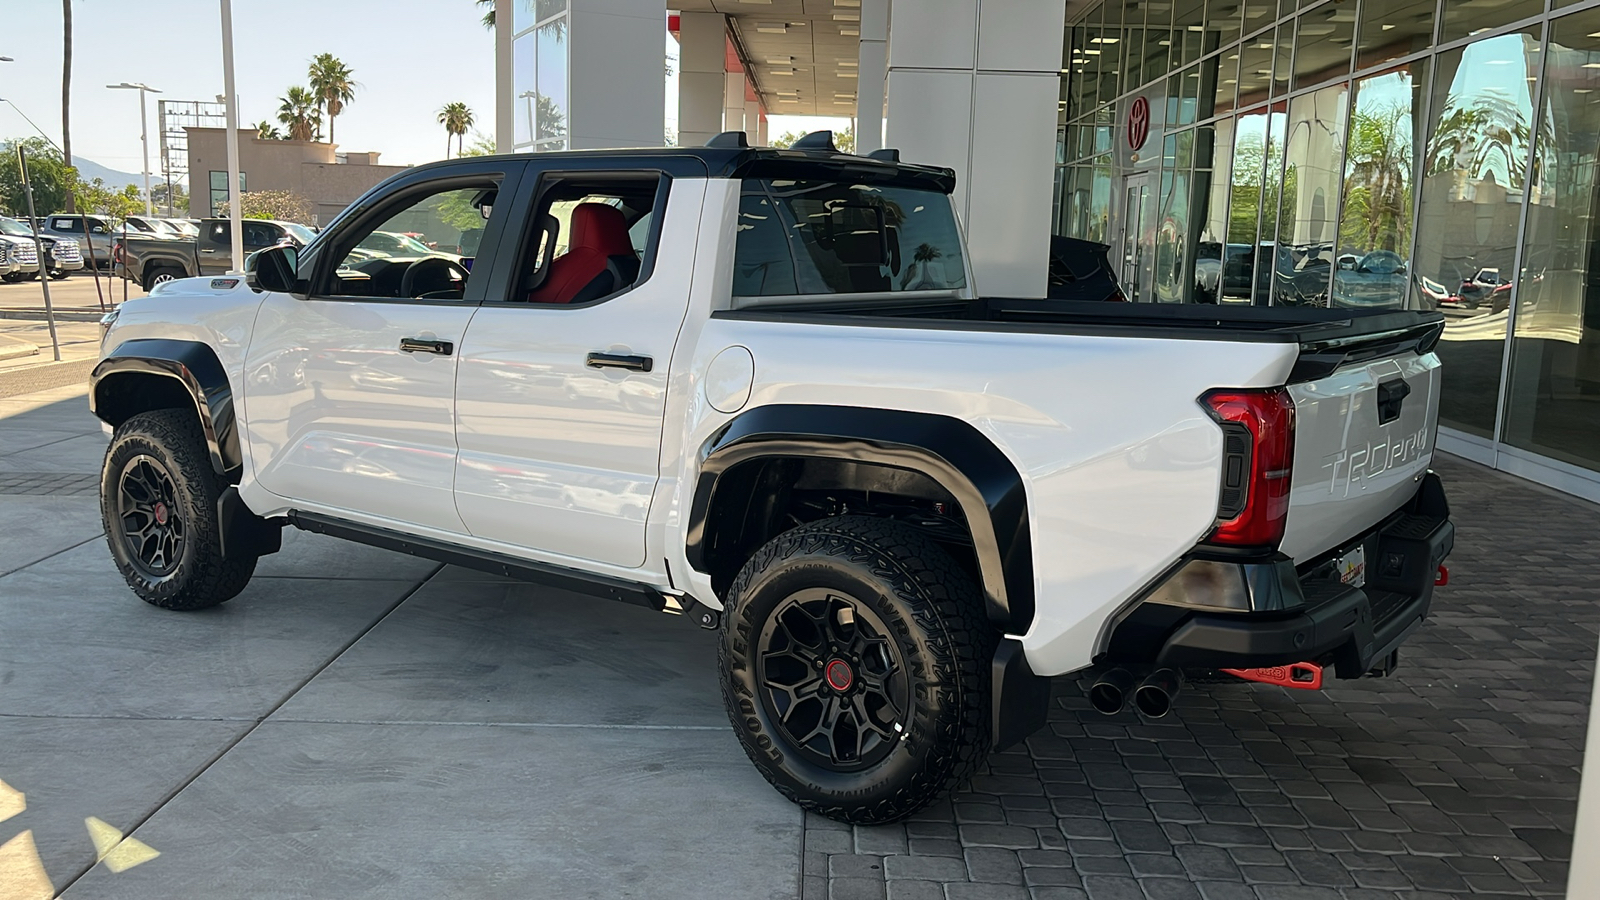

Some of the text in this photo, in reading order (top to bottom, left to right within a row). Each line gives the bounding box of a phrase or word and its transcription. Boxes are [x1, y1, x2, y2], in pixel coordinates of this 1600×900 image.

[110, 438, 167, 467] WRANGLER
[731, 603, 785, 766] GOODYEAR
[876, 594, 929, 758] WRANGLER
